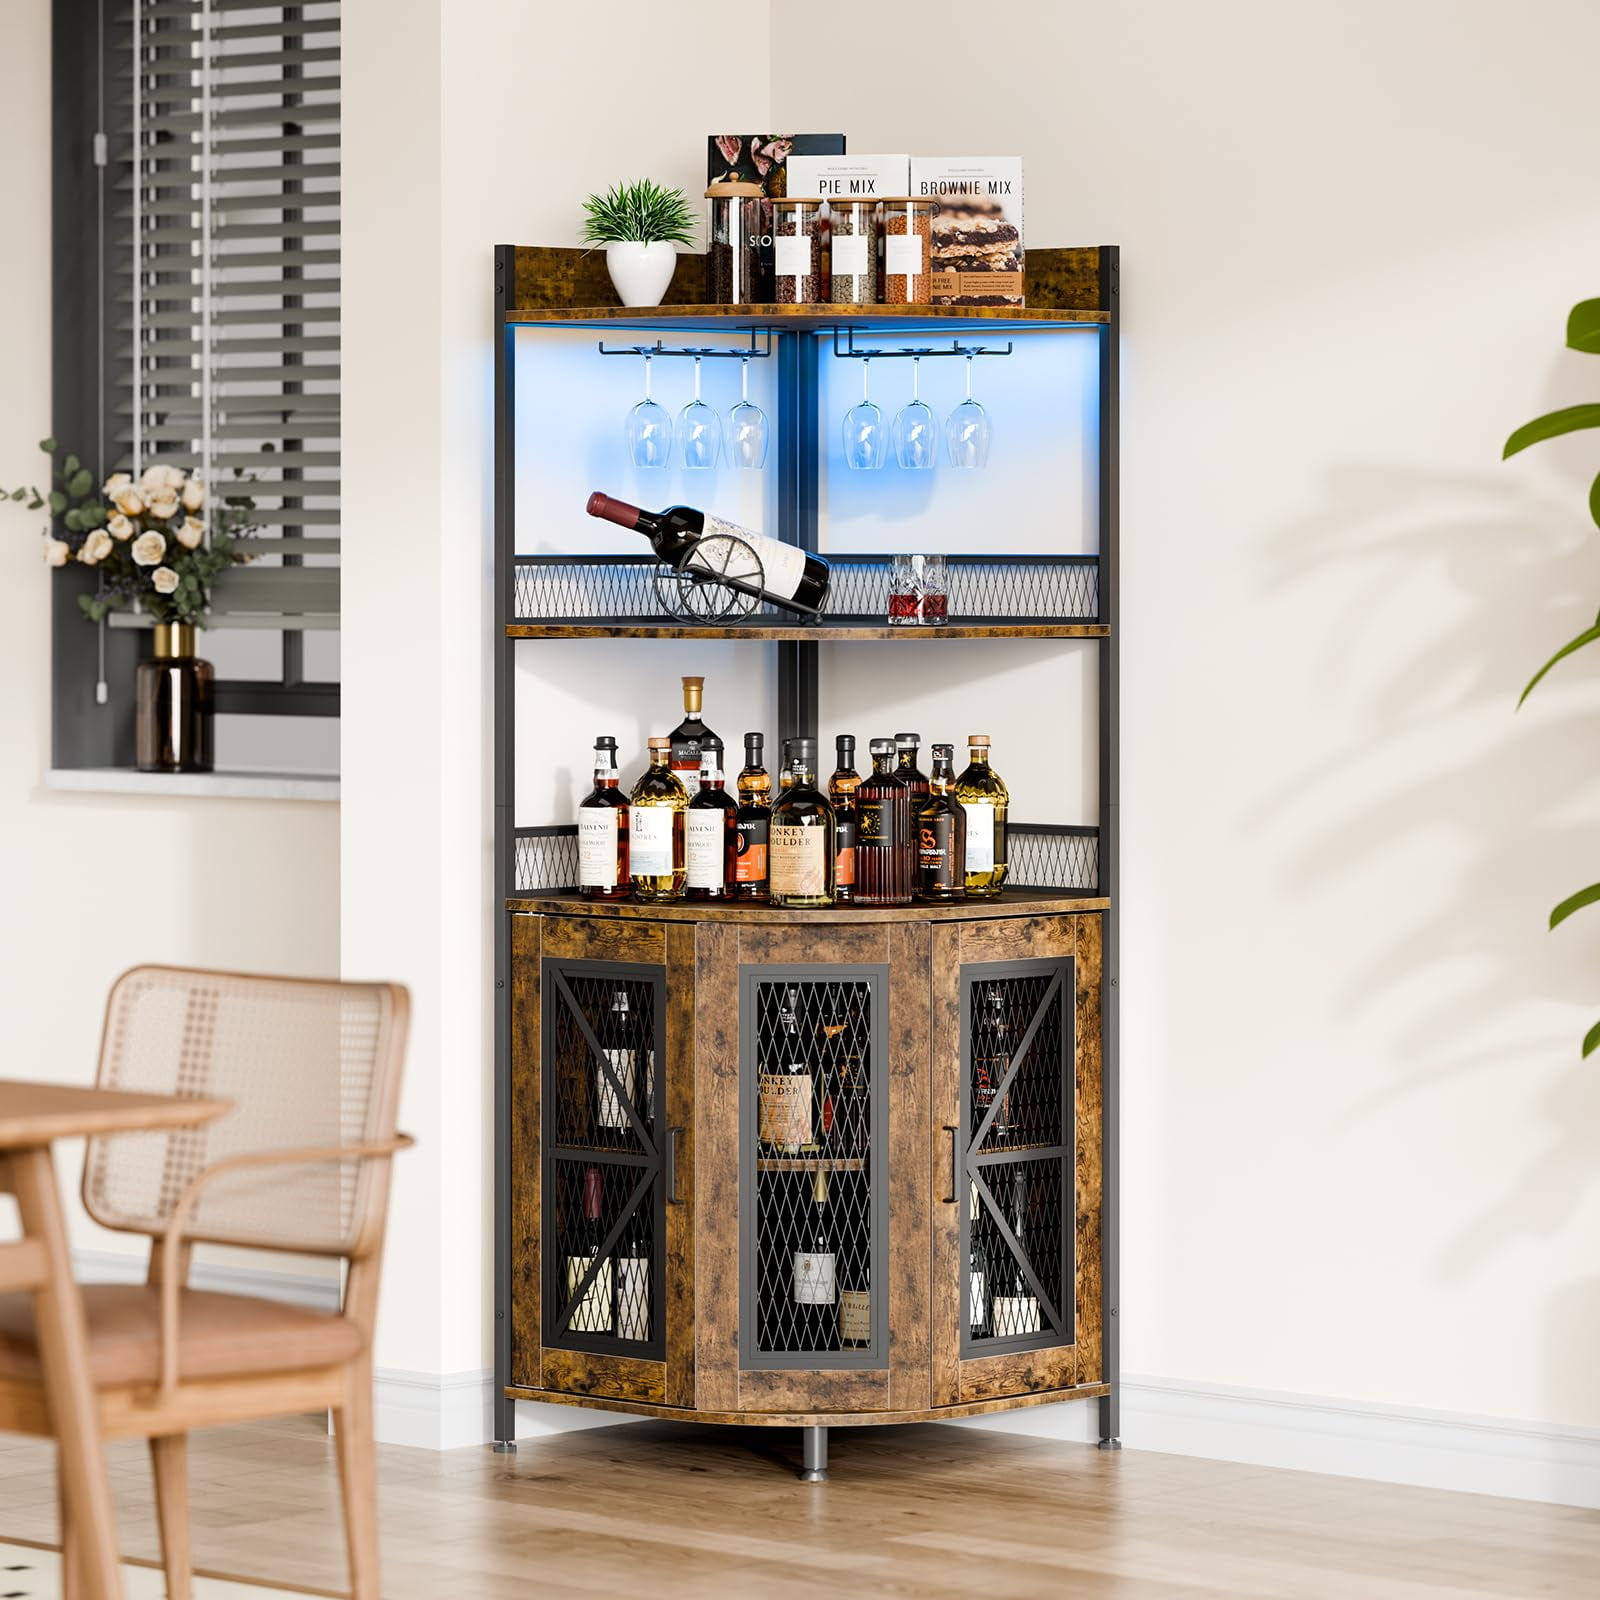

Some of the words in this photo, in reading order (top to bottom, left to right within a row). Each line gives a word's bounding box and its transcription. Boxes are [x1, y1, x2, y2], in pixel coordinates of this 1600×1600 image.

[819, 179, 842, 194] PIE
[850, 179, 876, 194] MIX
[920, 180, 981, 196] BROWNIE
[988, 180, 1012, 195] MIX
